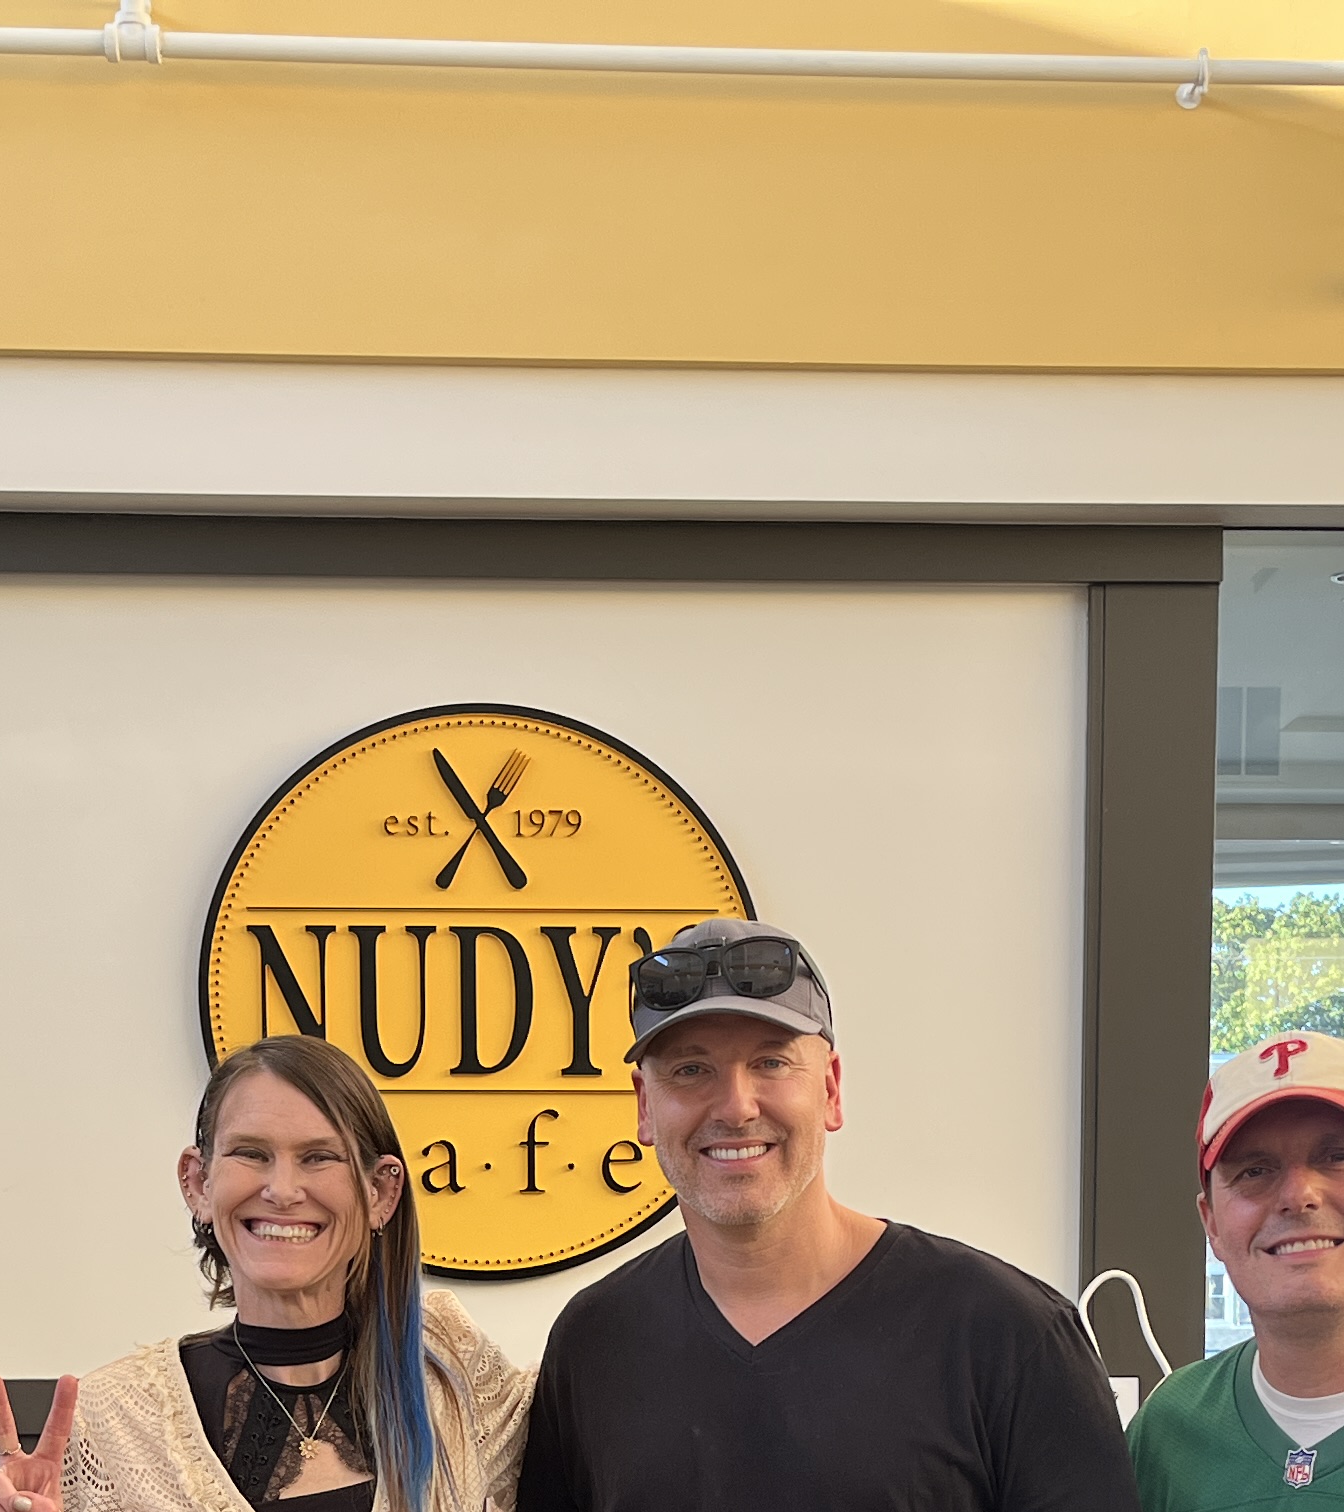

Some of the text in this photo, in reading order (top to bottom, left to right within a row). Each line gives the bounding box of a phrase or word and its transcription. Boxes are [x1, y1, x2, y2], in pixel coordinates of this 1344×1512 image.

[383, 808, 583, 838] est. 1979
[246, 923, 698, 1079] NUDY'
[1258, 1038, 1309, 1080] P
